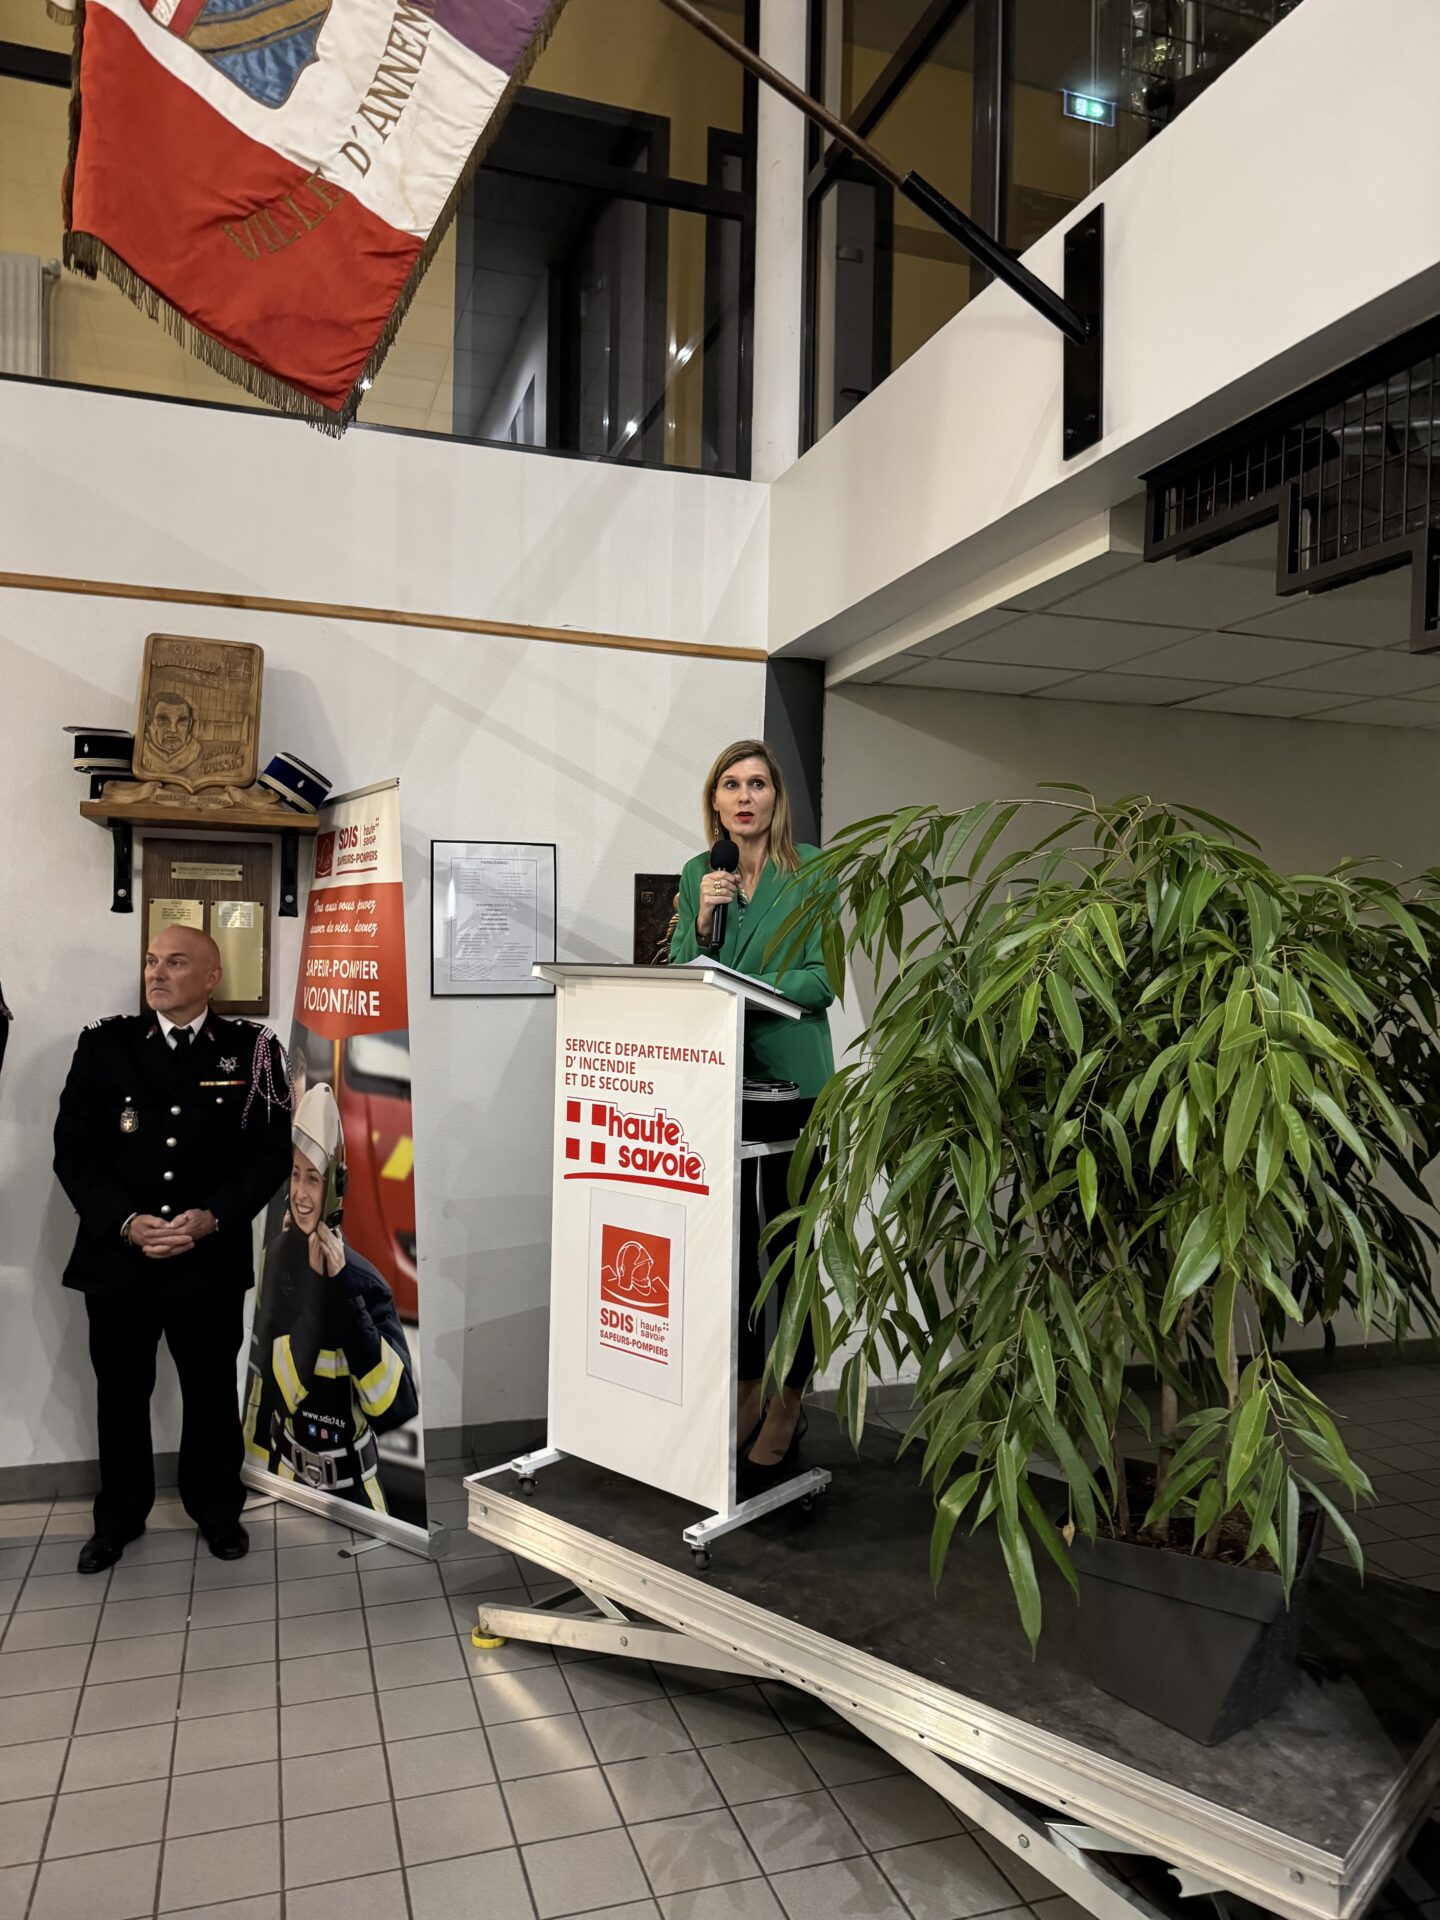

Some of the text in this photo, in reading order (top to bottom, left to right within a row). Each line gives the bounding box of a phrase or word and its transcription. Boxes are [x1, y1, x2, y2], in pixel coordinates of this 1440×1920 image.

[219, 166, 345, 261] VILLE
[338, 825, 358, 851] SDIS
[306, 959, 379, 980] SAPEUR-POMPIER
[303, 986, 380, 1017] VOLONTAIRE
[565, 1038, 725, 1065] SERVICE DEPARTEMENTAL
[579, 1057, 636, 1075] INCENDIE
[565, 1072, 654, 1095] ET DE SECOURS
[608, 1106, 680, 1146] haute
[618, 1145, 702, 1180] savoie
[600, 1307, 634, 1333] SDIS
[640, 1319, 662, 1333] haute
[600, 1329, 669, 1358] SAPEURS-POMPIERS
[640, 1329, 665, 1343] savoie
